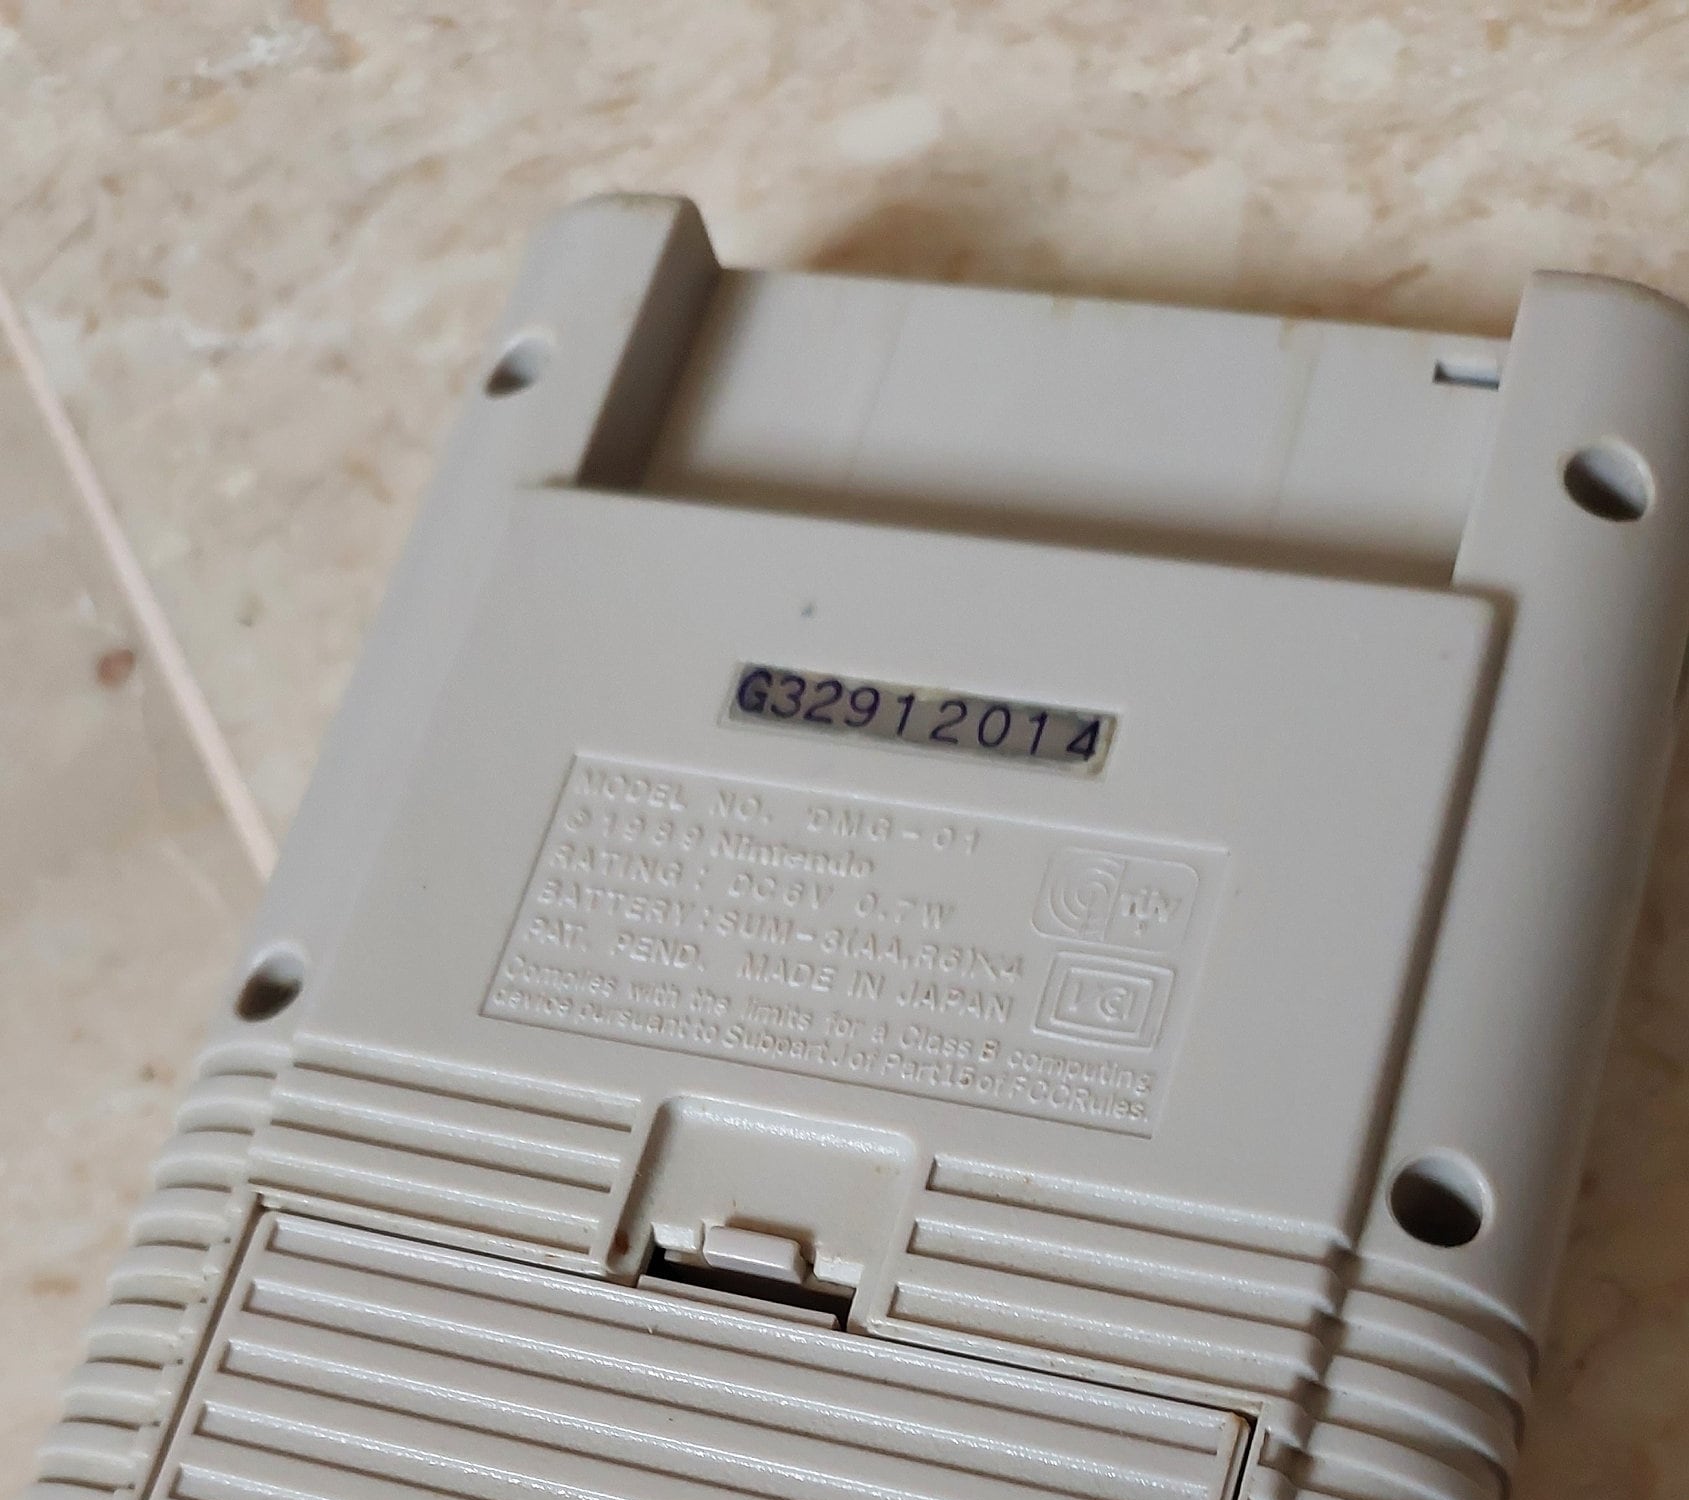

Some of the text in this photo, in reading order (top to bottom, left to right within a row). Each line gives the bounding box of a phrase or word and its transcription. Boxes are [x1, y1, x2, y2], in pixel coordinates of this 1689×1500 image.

[736, 667, 1101, 762] G32912014
[575, 767, 687, 812] MODEL
[709, 790, 772, 824] NO.
[709, 831, 876, 879] Nintendo
[855, 892, 956, 930] 0.7W
[492, 985, 574, 1017] device
[735, 952, 839, 992] MADE
[847, 968, 886, 1001] IN
[896, 979, 1014, 1023] JAPAN
[504, 954, 1152, 1097] Complies with the limits for a Class B computing
